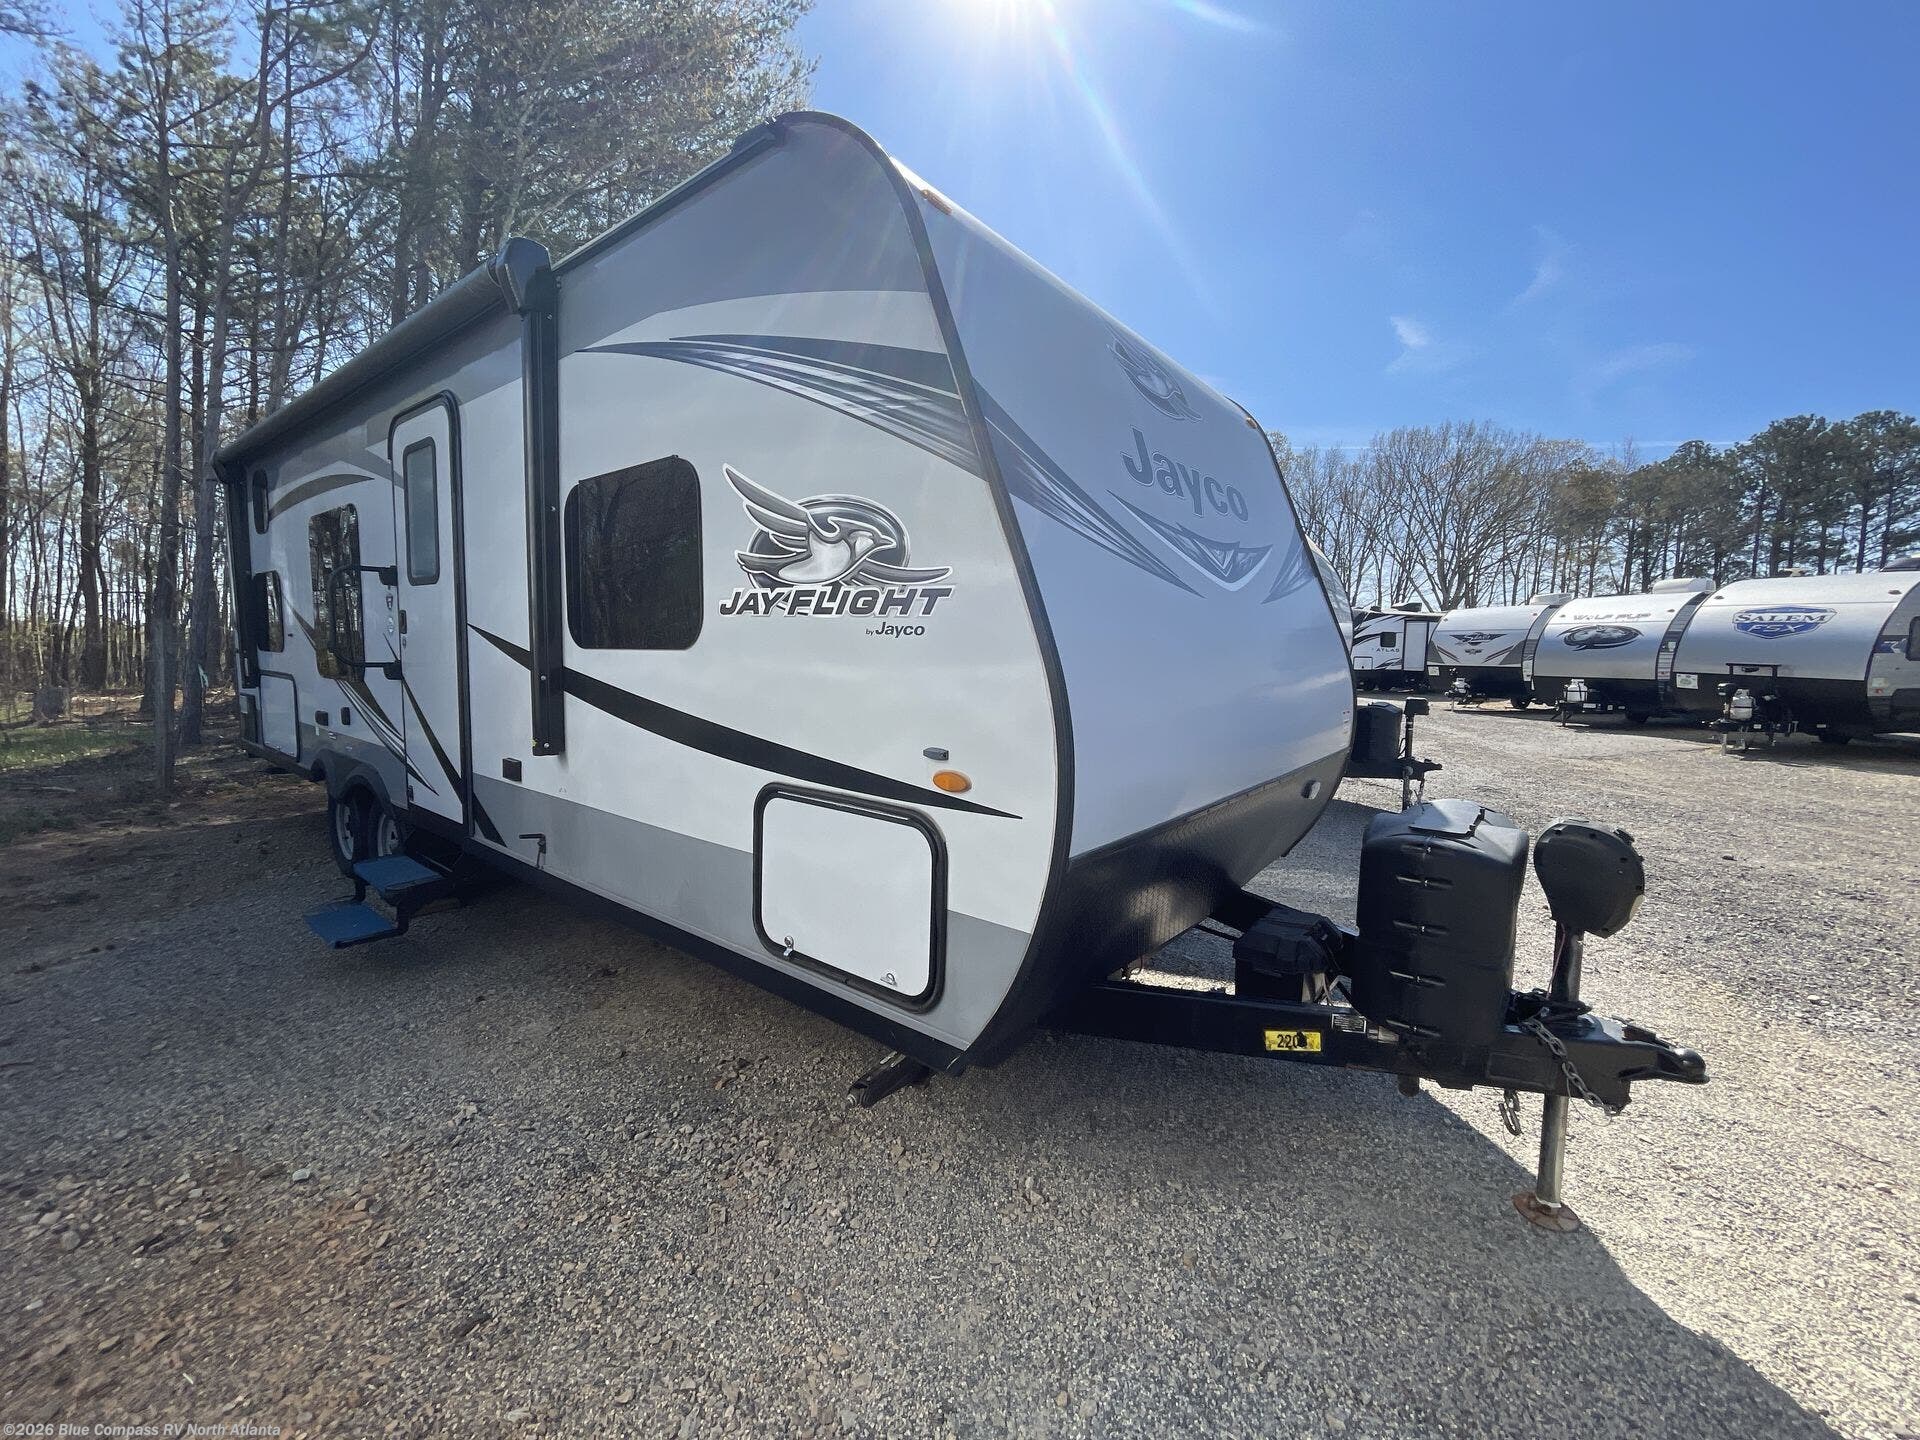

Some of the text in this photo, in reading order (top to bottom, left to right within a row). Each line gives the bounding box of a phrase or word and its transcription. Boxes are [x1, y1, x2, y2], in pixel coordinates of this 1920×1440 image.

[1120, 424, 1249, 522] Jayco
[719, 586, 954, 617] JAY FLIGHT
[1735, 613, 1827, 622] SALEM
[865, 621, 926, 638] by Jayco
[1747, 623, 1805, 633] FSX
[1276, 1033, 1308, 1049] 220
